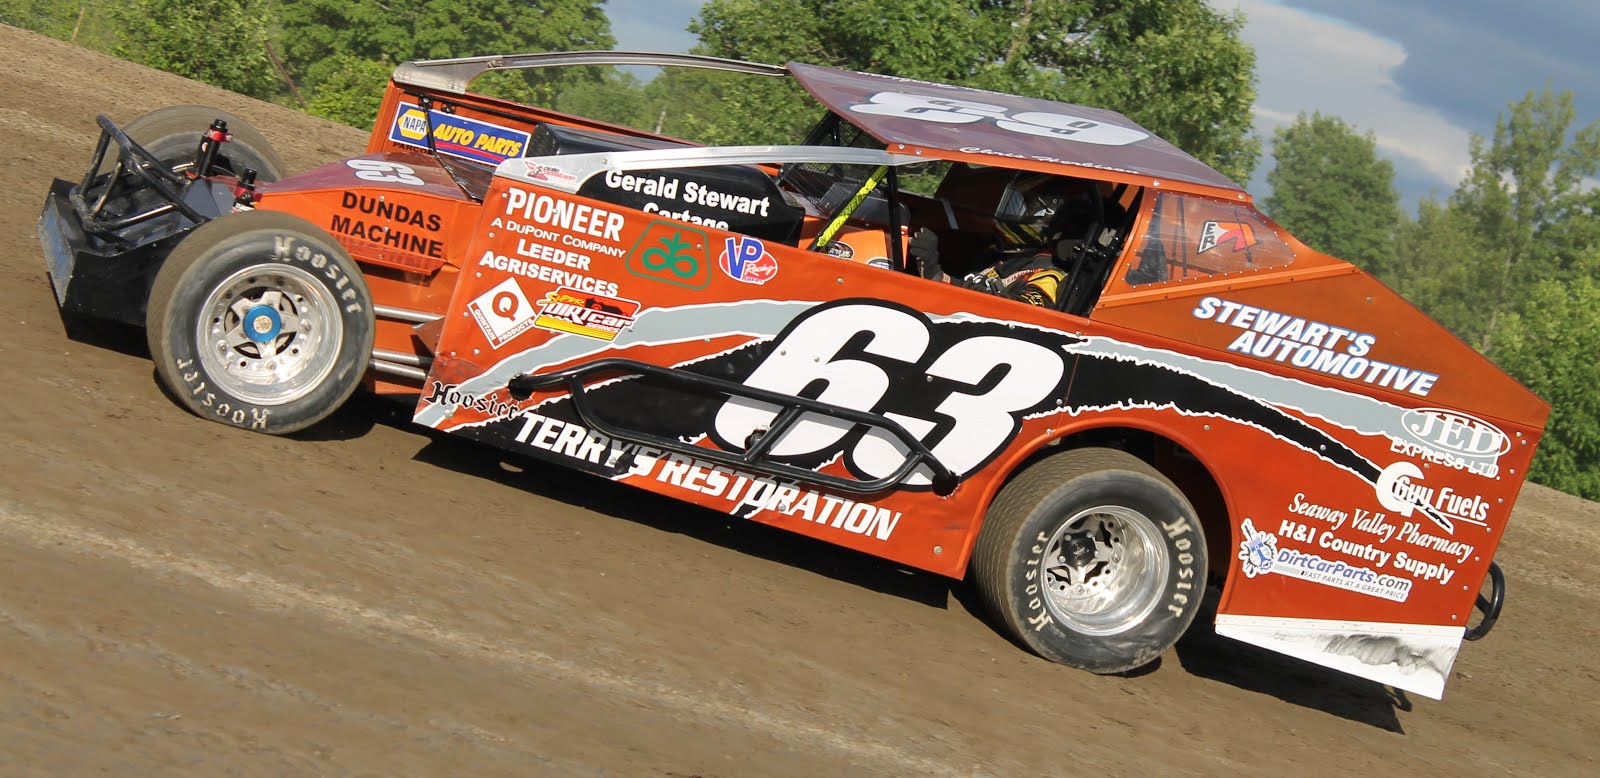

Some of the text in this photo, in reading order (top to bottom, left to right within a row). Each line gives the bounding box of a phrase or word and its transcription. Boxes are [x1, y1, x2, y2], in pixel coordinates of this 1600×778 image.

[403, 115, 426, 133] NAPA
[433, 123, 523, 157] AUTO PARTS
[346, 159, 425, 186] 63
[605, 169, 770, 217] Gerald Stewart
[342, 191, 442, 232] DUNDAS
[506, 187, 624, 242] PIONEER
[331, 214, 443, 258] MACHINE
[491, 217, 503, 229] A
[562, 234, 627, 258] COMPANY
[516, 238, 591, 271] LEEDER
[272, 235, 363, 314] Hoosier
[480, 250, 619, 298] AGRISERVICES
[727, 238, 764, 279] VP
[492, 291, 519, 322] Q
[547, 294, 585, 307] SUPER
[474, 309, 496, 341] QUINTAIN
[499, 319, 534, 343] PRODUCTS
[1193, 297, 1376, 357] STEWART'S
[1228, 330, 1440, 397] AUTOMOTIVE
[177, 358, 272, 430] Hoosier
[424, 379, 519, 421] Hoosier
[714, 304, 1065, 486] 63
[1411, 411, 1501, 453] JED
[513, 411, 901, 541] TERRY'S RESTORATION
[1390, 436, 1501, 481] EXPRESS LTD.
[1436, 487, 1490, 521] Fuels
[1288, 492, 1474, 563] Seaway Valley Pharmacy
[1161, 516, 1194, 618] Hoosier
[1277, 550, 1409, 591] DirtCarParts.com
[1278, 519, 1455, 585] H&I Country Supply
[1025, 530, 1054, 632] Hoosier
[1304, 570, 1321, 580] FAST
[1322, 575, 1343, 585] PARTS
[1362, 584, 1384, 595] GREAT
[1385, 589, 1405, 600] PRICE
